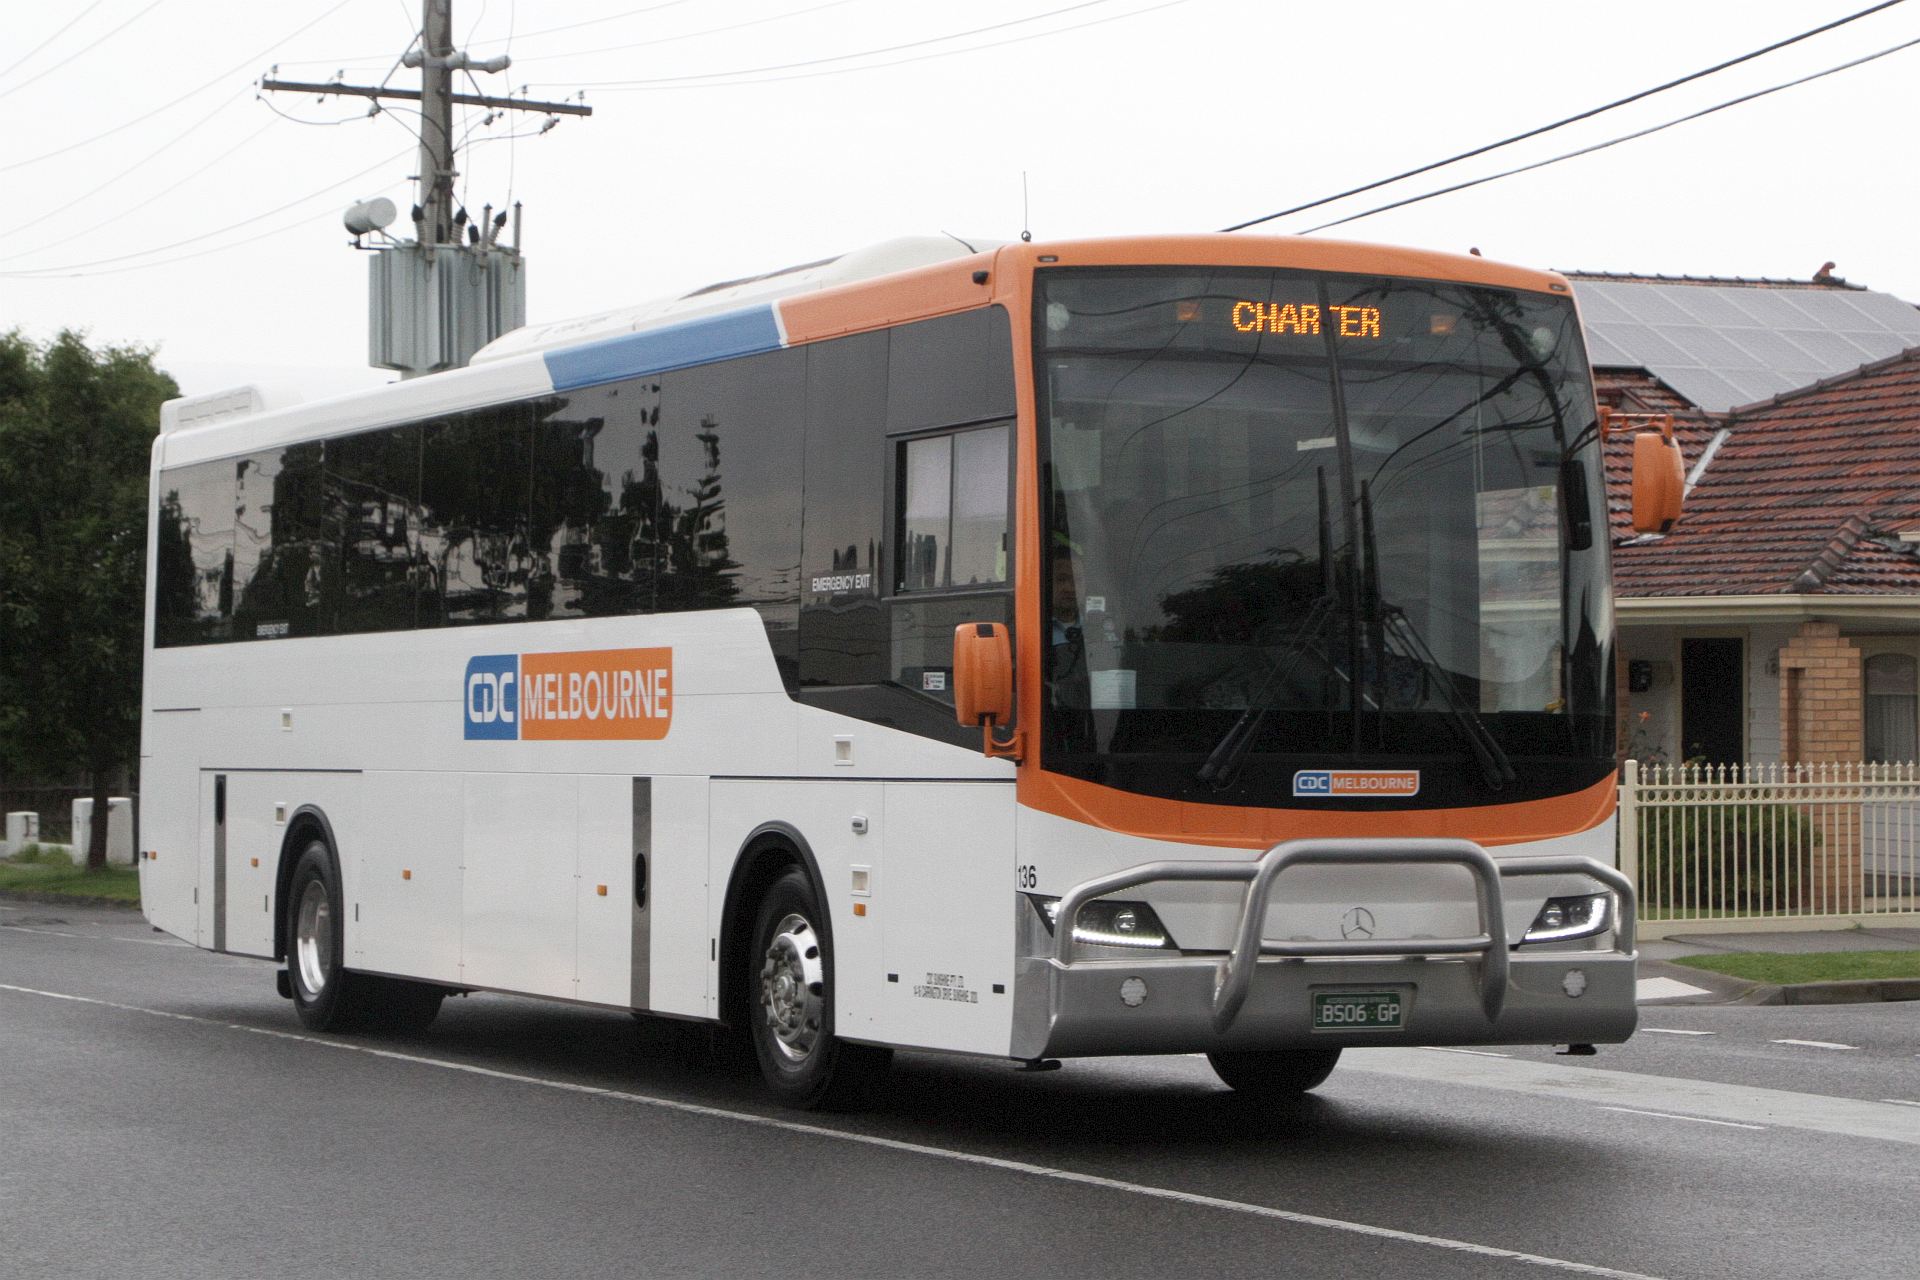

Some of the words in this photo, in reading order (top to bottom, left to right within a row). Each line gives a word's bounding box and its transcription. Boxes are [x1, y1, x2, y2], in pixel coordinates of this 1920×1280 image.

[812, 575, 854, 592] EMERGENCY
[855, 573, 871, 589] EXIT
[468, 671, 515, 724] CDC
[524, 668, 668, 720] MELBOURNE
[1298, 776, 1329, 790] CDC
[1333, 776, 1415, 790] MELBOURNE
[1017, 864, 1037, 889] 136
[1322, 1004, 1367, 1023] BS06
[1377, 1003, 1400, 1022] GP
